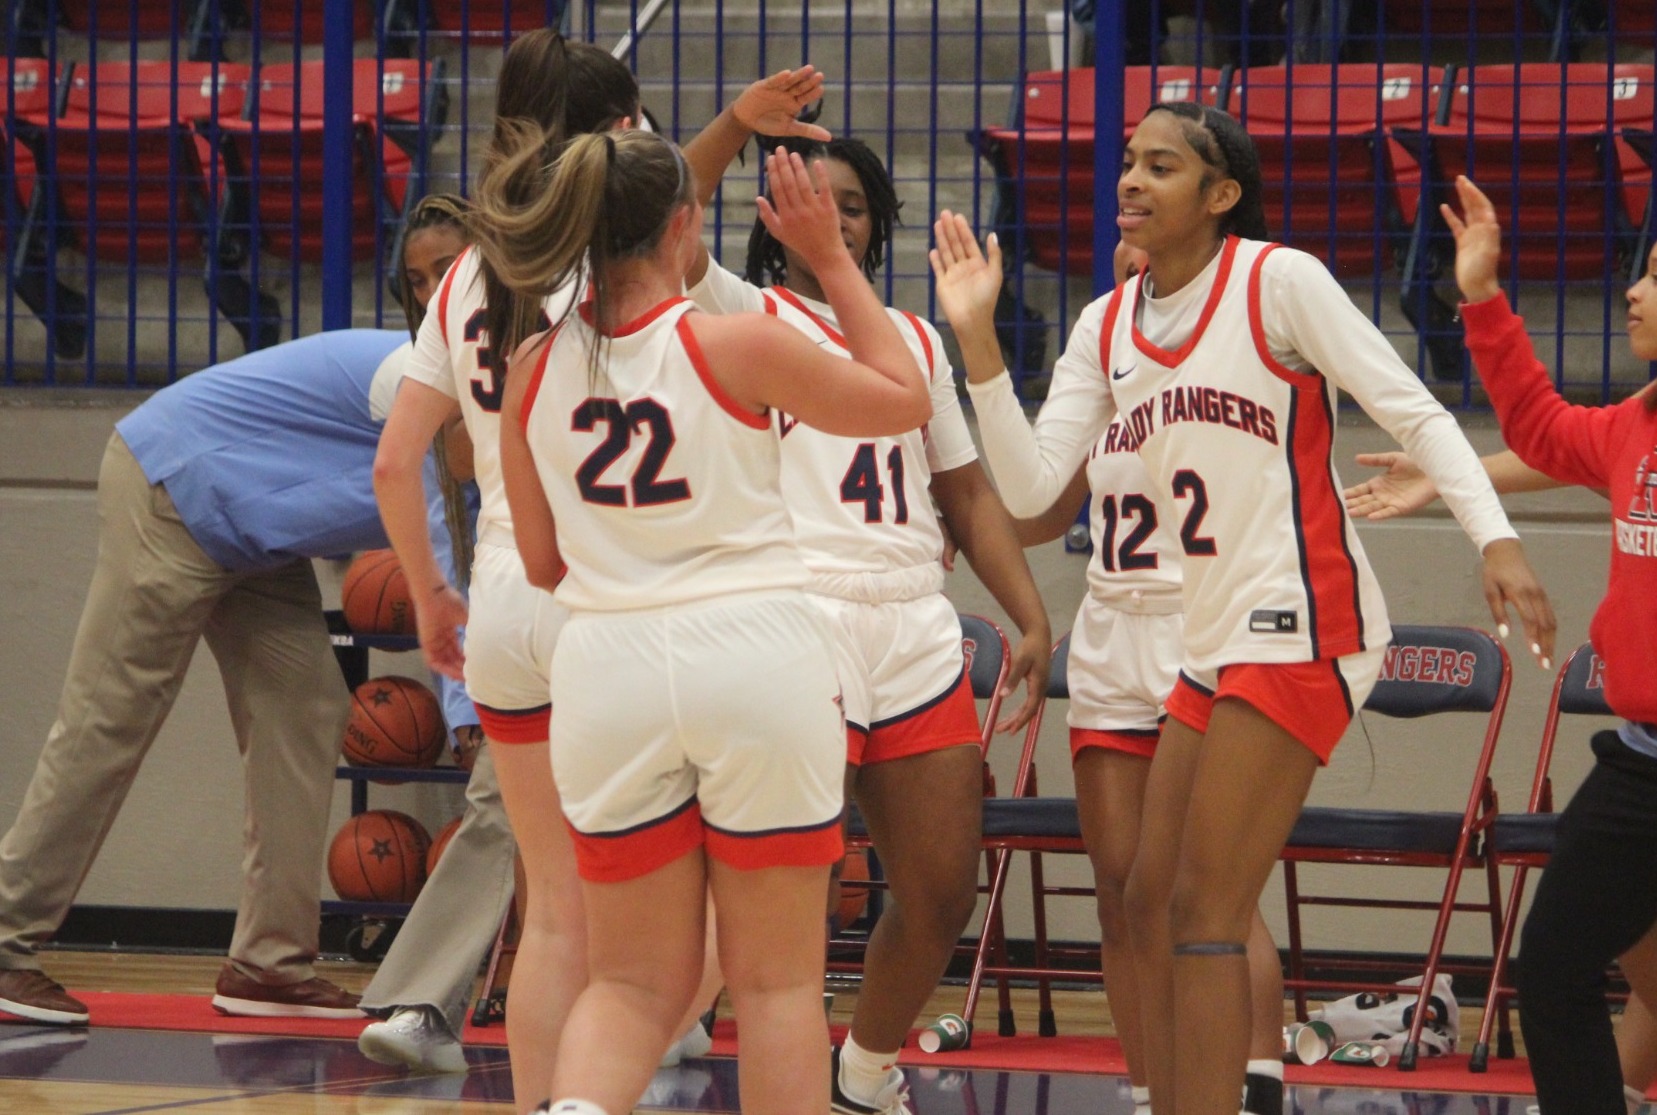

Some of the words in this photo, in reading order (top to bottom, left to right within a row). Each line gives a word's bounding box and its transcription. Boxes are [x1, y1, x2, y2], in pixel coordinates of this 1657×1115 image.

[570, 396, 693, 508] 22
[1161, 385, 1279, 446] RANGERS
[839, 442, 909, 526] 41
[1171, 468, 1218, 557] 2
[1101, 493, 1159, 574] 12
[1376, 645, 1477, 688] NGERS
